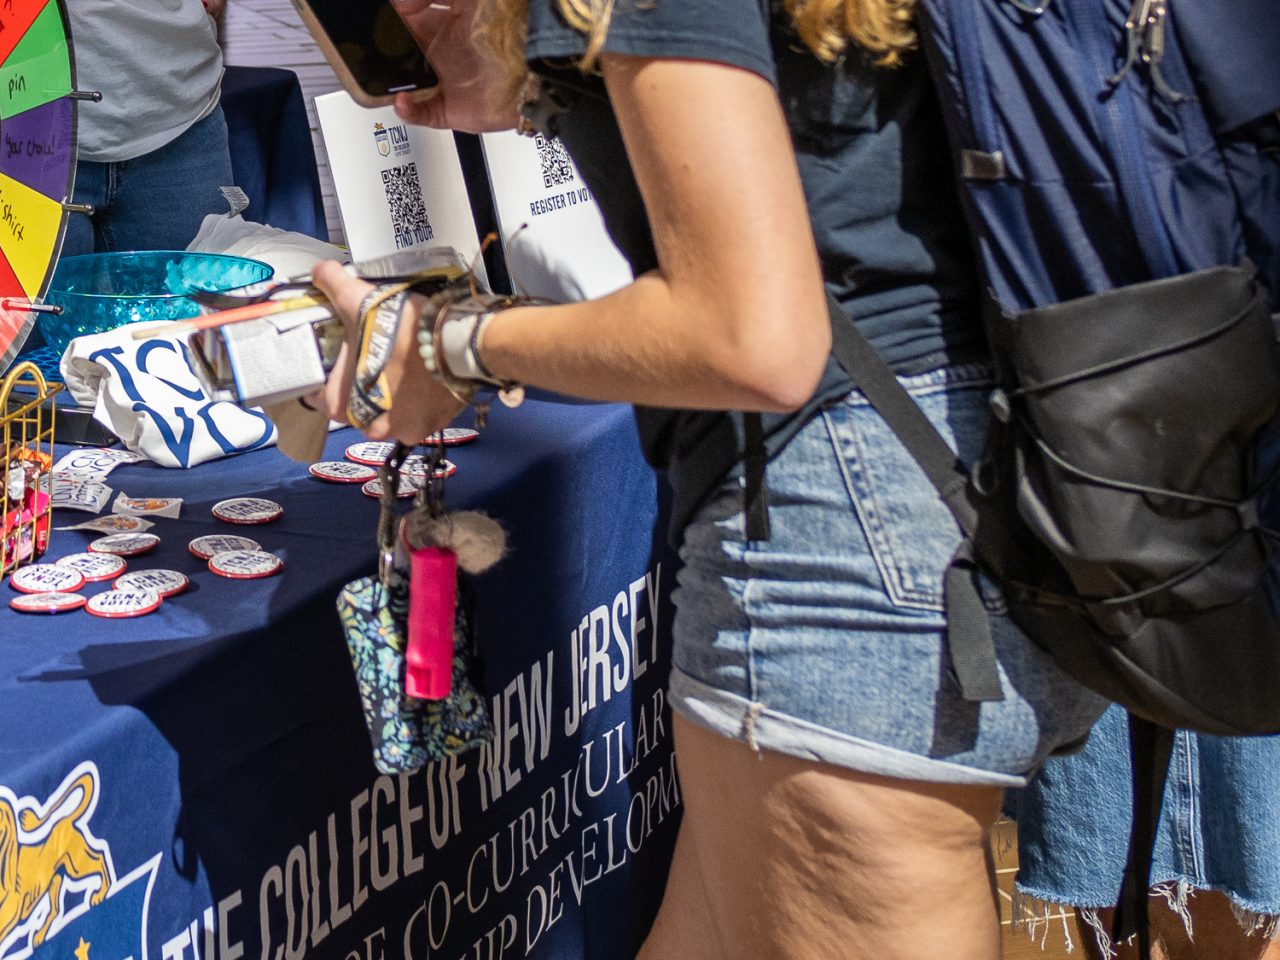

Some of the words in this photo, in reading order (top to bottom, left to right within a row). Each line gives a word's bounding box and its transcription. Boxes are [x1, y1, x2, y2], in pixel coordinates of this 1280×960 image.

[8, 73, 27, 100] pin
[388, 124, 409, 145] TCNJ
[529, 193, 567, 217] REGISTER
[566, 190, 578, 207] TO
[576, 187, 593, 203] VOT
[395, 229, 414, 250] FIND
[412, 224, 435, 244] YOUR
[132, 400, 275, 470] VO
[22, 572, 64, 588] TCNJ
[125, 571, 168, 586] TCNJ
[260, 768, 424, 960] COLLEGE
[426, 751, 467, 850] OF
[477, 650, 554, 812] NEW
[564, 562, 661, 737] JERSEY
[404, 687, 665, 960] CO-CURRICULAR
[524, 752, 680, 957] DEVELOPM
